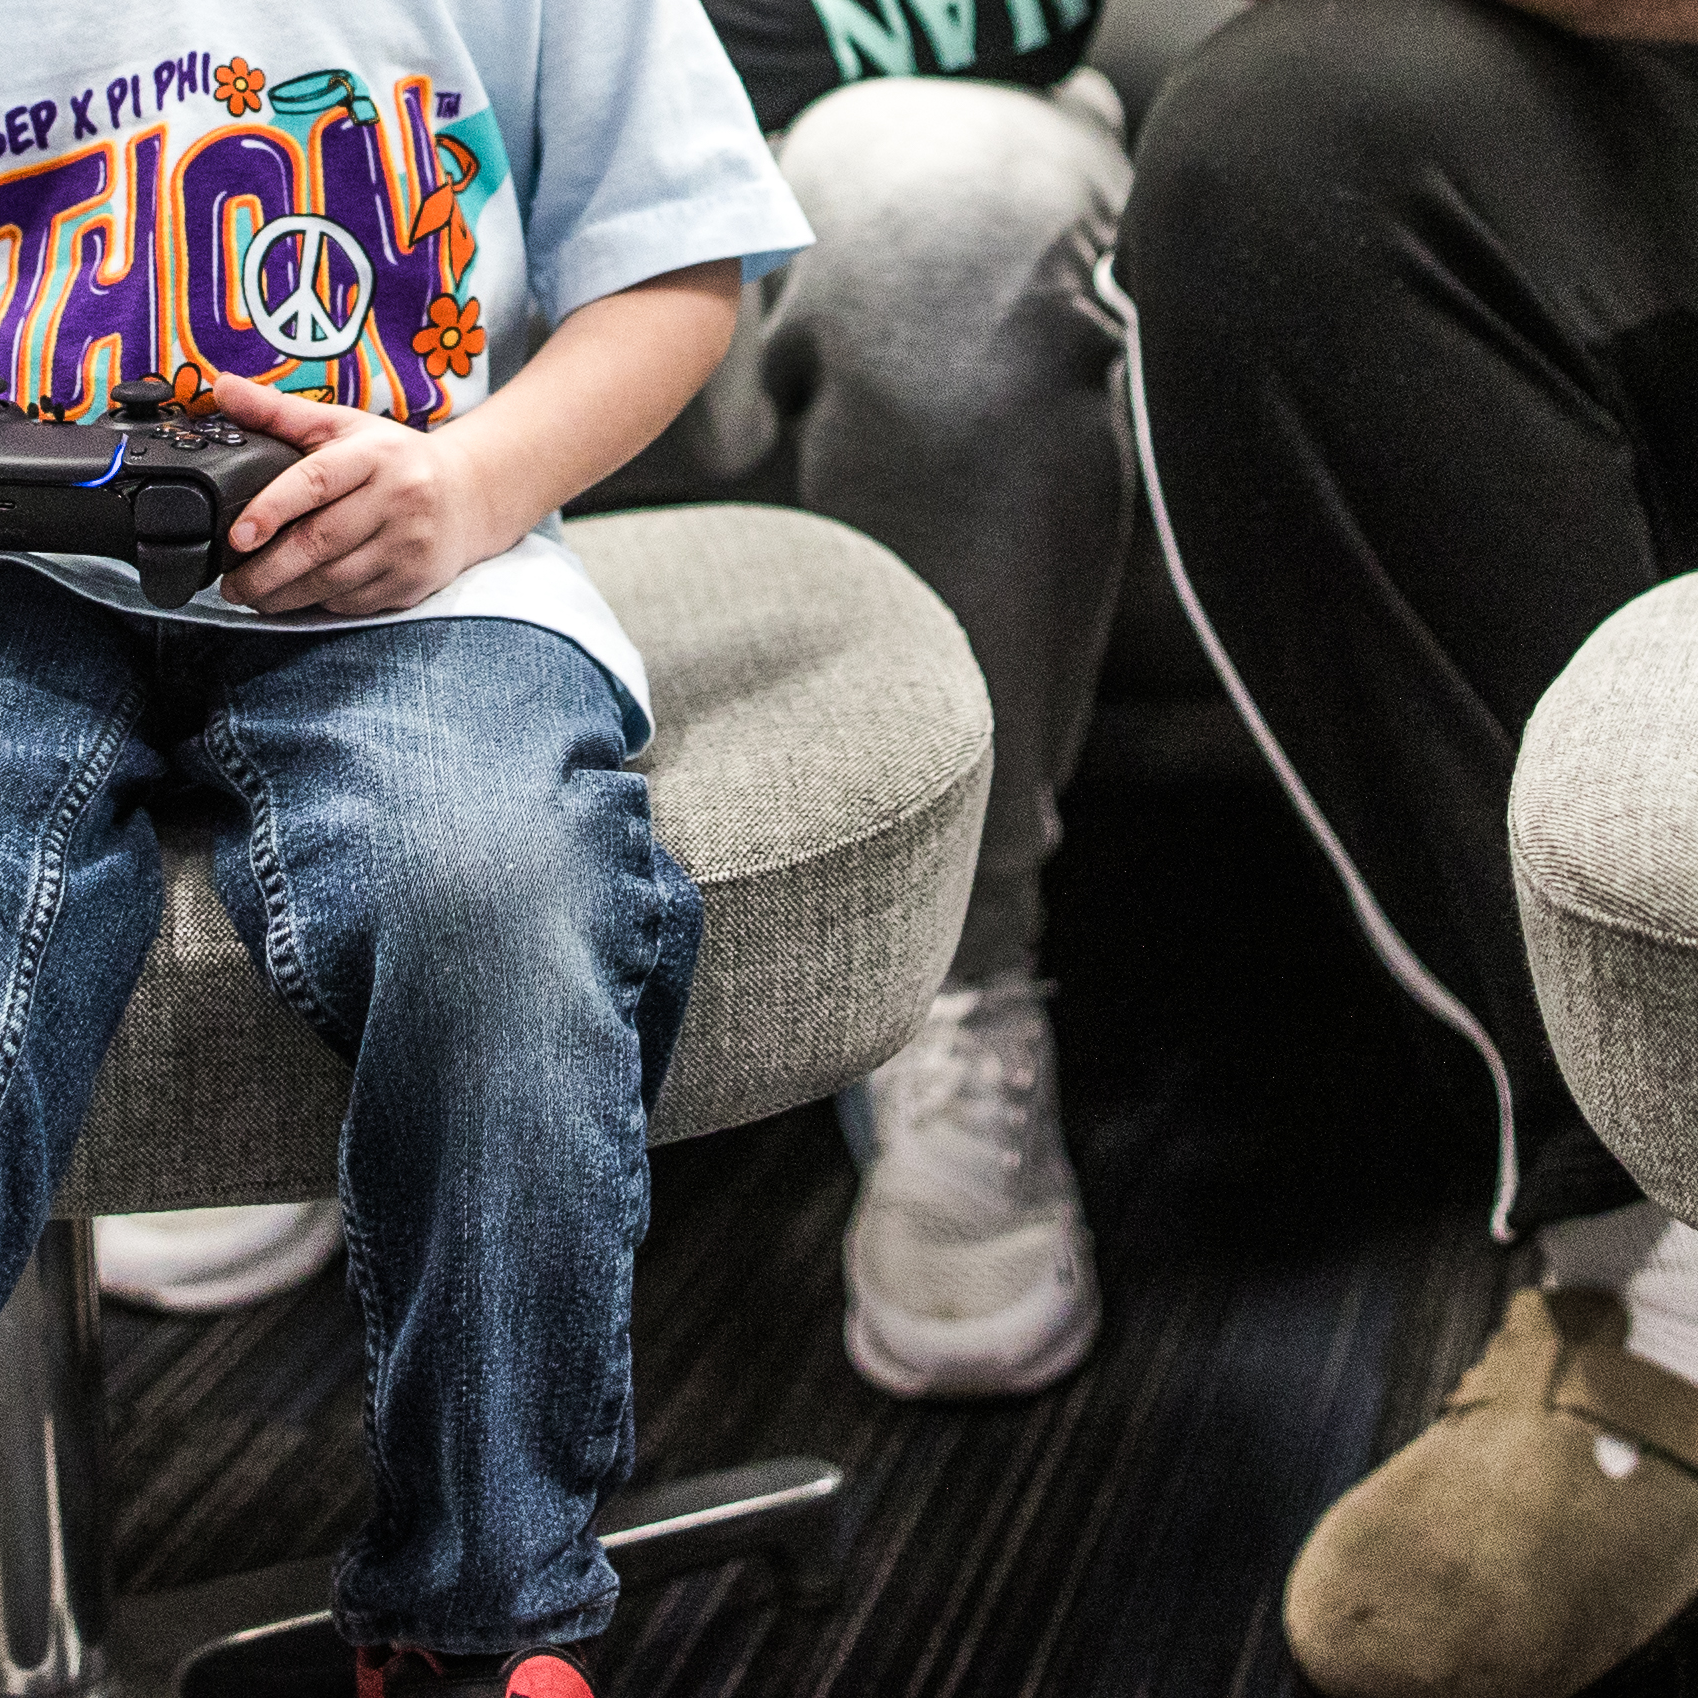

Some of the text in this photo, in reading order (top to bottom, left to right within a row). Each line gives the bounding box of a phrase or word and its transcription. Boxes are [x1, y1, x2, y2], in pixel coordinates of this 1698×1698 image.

[73, 89, 99, 139] X
[106, 74, 141, 130] PI
[154, 50, 212, 110] PHI
